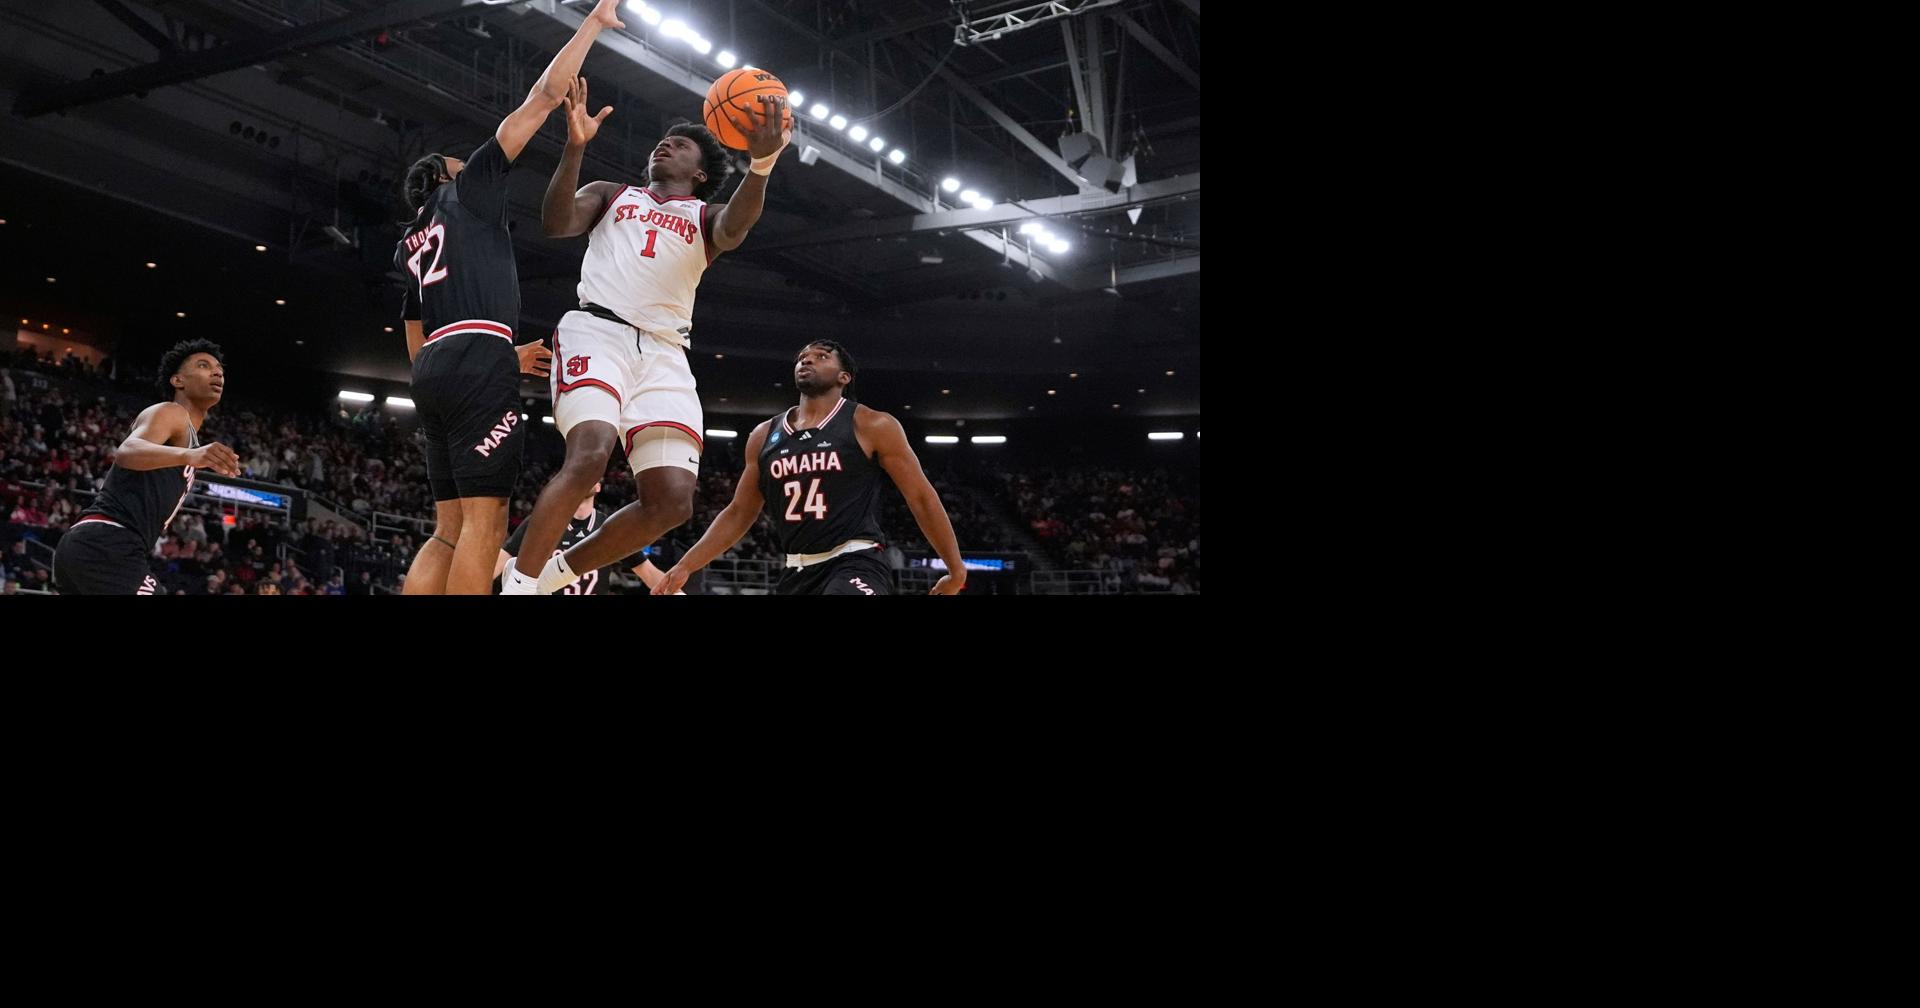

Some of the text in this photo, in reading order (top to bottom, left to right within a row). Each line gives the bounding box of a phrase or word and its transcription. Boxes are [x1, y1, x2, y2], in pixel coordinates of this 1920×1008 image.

[640, 229, 658, 259] 1
[474, 410, 518, 458] MAVS
[770, 451, 842, 479] OMAHA
[783, 478, 828, 522] 24
